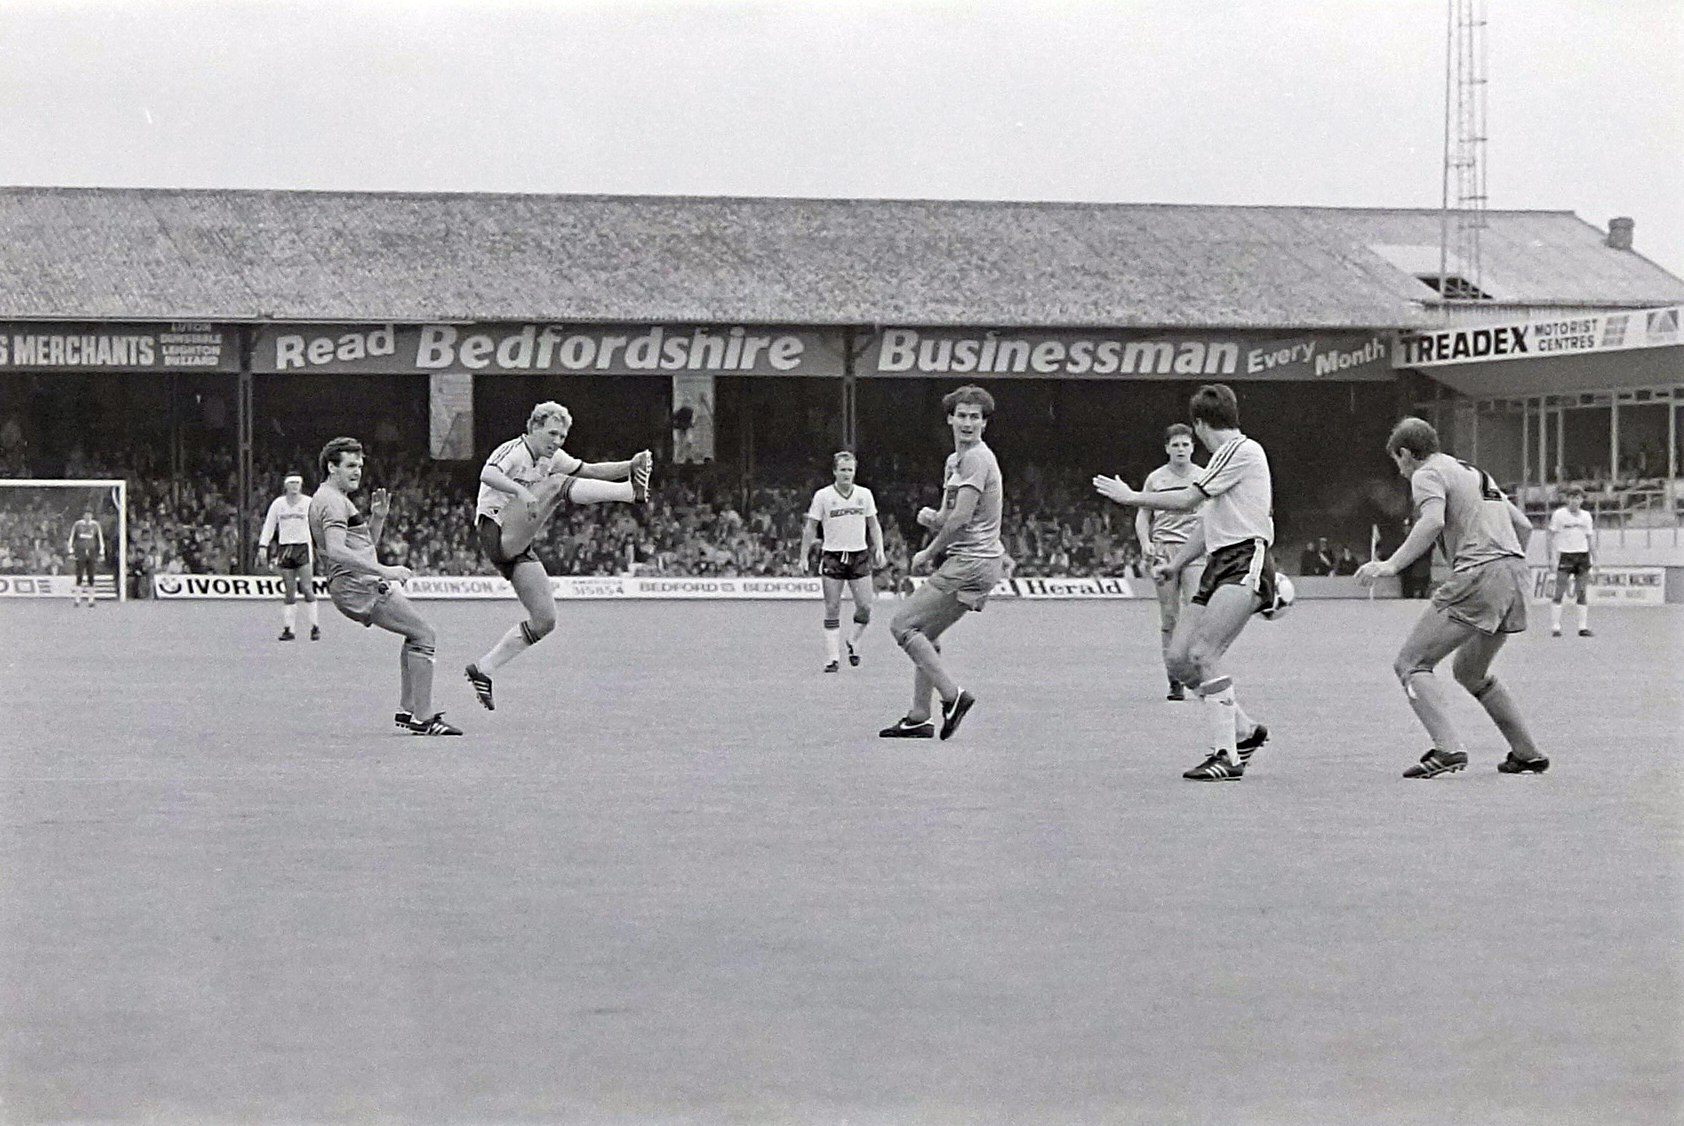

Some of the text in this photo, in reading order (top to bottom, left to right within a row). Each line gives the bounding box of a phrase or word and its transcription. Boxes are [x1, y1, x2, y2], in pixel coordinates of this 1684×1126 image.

[1534, 319, 1598, 335] MOTORIST
[13, 335, 154, 365] MERCHANTS
[276, 325, 1238, 374] Read Bedfordshire Businessman
[1400, 325, 1528, 364] TREADEX
[1538, 334, 1595, 352] CENTRES
[1247, 337, 1385, 376] Every Month
[187, 579, 250, 594] IVOR
[405, 580, 493, 594] ARKINSON
[640, 582, 820, 592] BEDFORD BEDFORD
[1026, 579, 1123, 595] Herald
